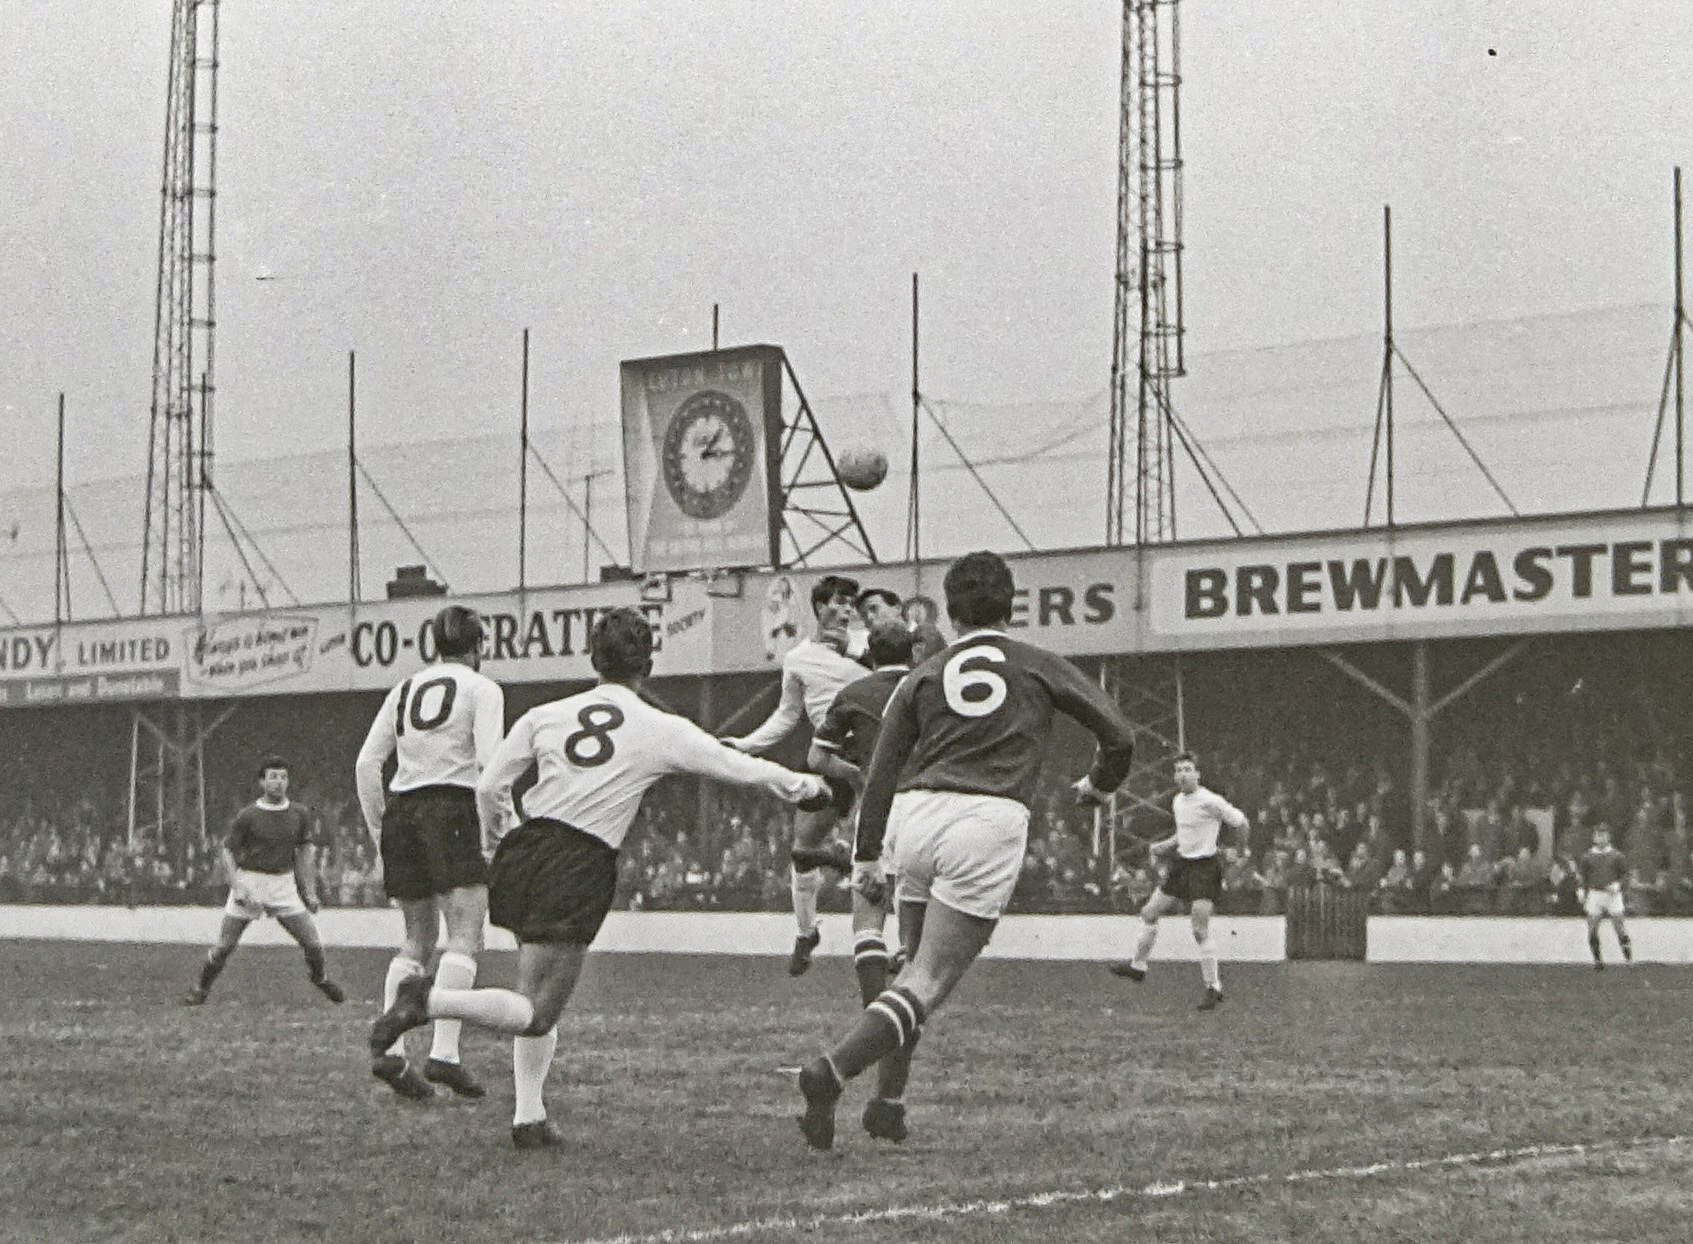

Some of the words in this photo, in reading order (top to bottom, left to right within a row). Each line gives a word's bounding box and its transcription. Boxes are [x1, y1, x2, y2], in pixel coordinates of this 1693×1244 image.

[1184, 537, 1693, 620] BREWMASTER
[78, 637, 170, 667] LIMITED
[352, 603, 663, 668] CO-OERATIE
[395, 677, 456, 737] 10
[943, 645, 1007, 717] 6
[565, 703, 624, 768] 8
